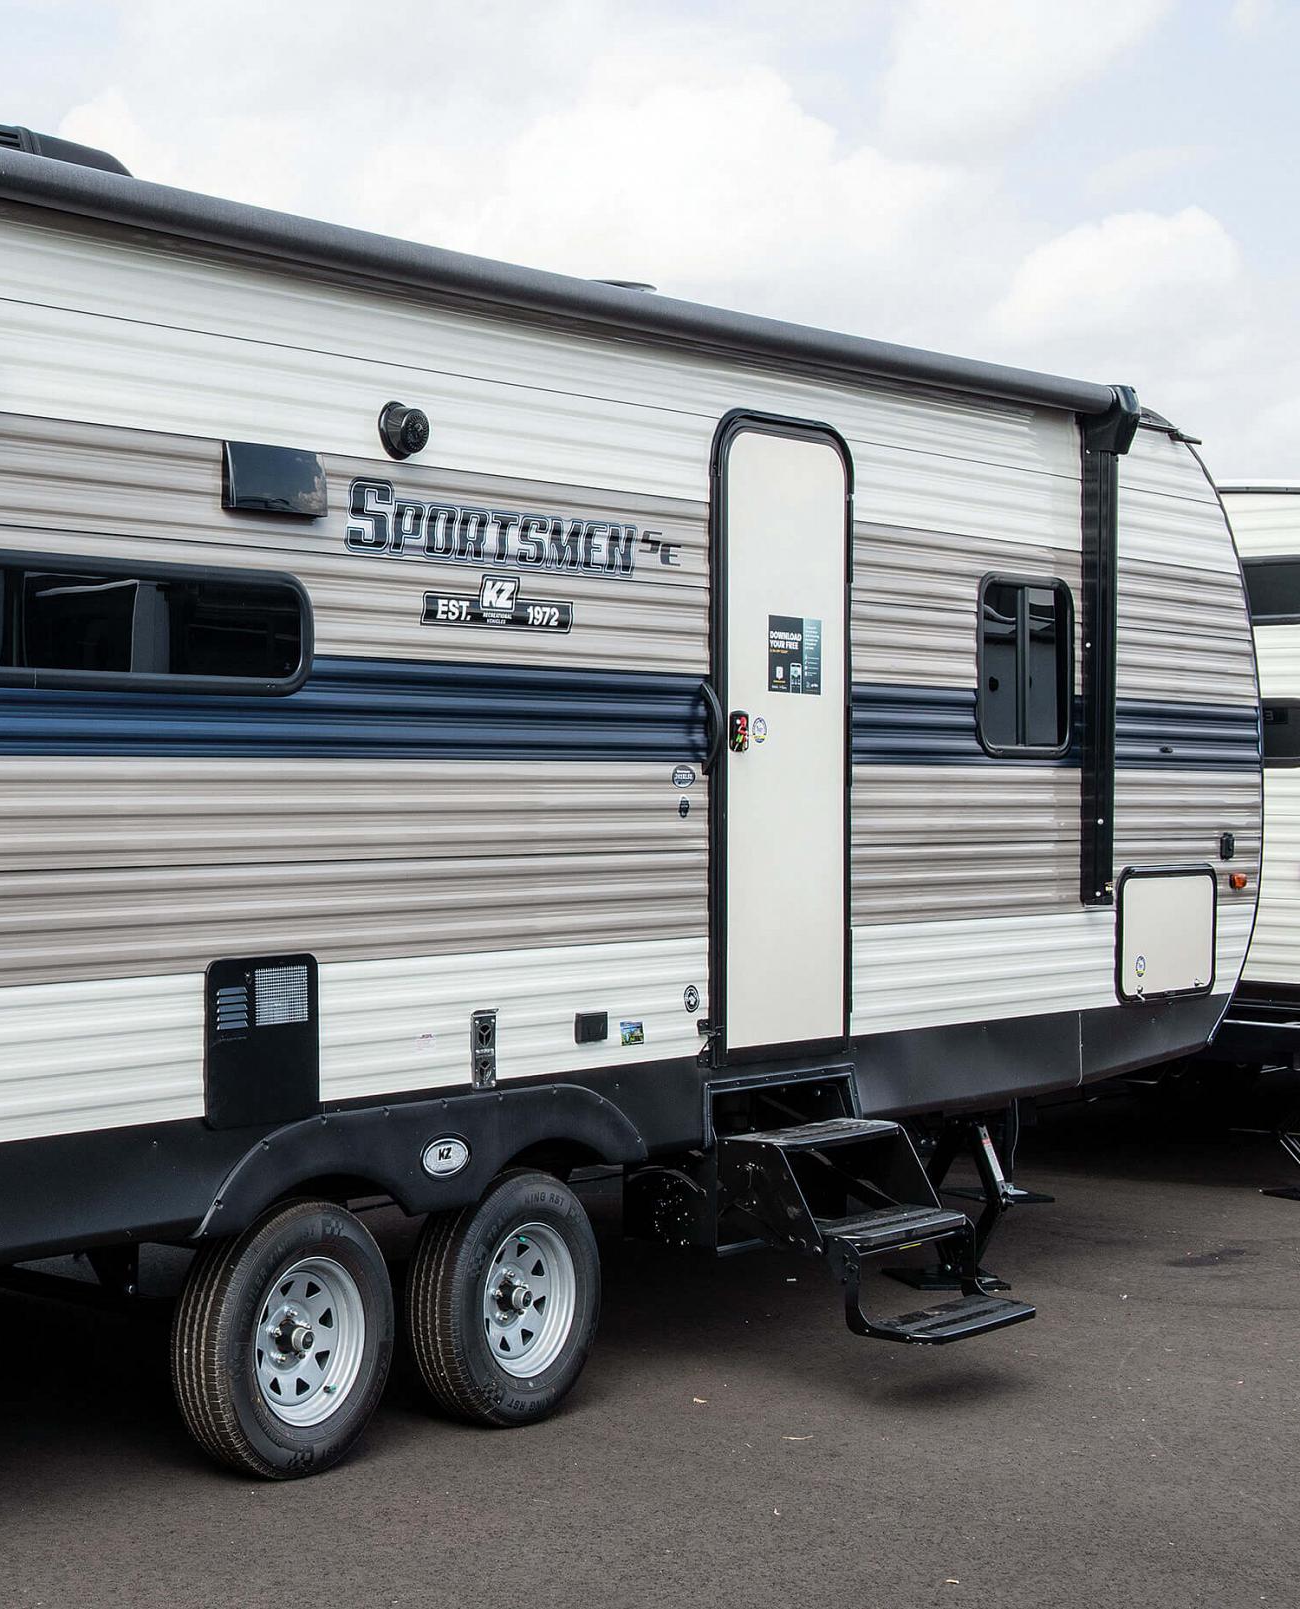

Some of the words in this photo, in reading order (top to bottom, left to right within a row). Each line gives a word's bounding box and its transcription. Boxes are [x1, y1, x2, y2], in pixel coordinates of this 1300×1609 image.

[345, 477, 638, 577] SPORTSMEN
[638, 531, 682, 566] SE
[483, 580, 515, 608] KZ
[436, 599, 471, 621] EST.
[527, 606, 560, 626] 1972
[769, 630, 802, 642] DOWNLOAD
[770, 640, 785, 649] YOUR
[785, 641, 799, 650] FREE
[438, 1146, 453, 1161] KZ
